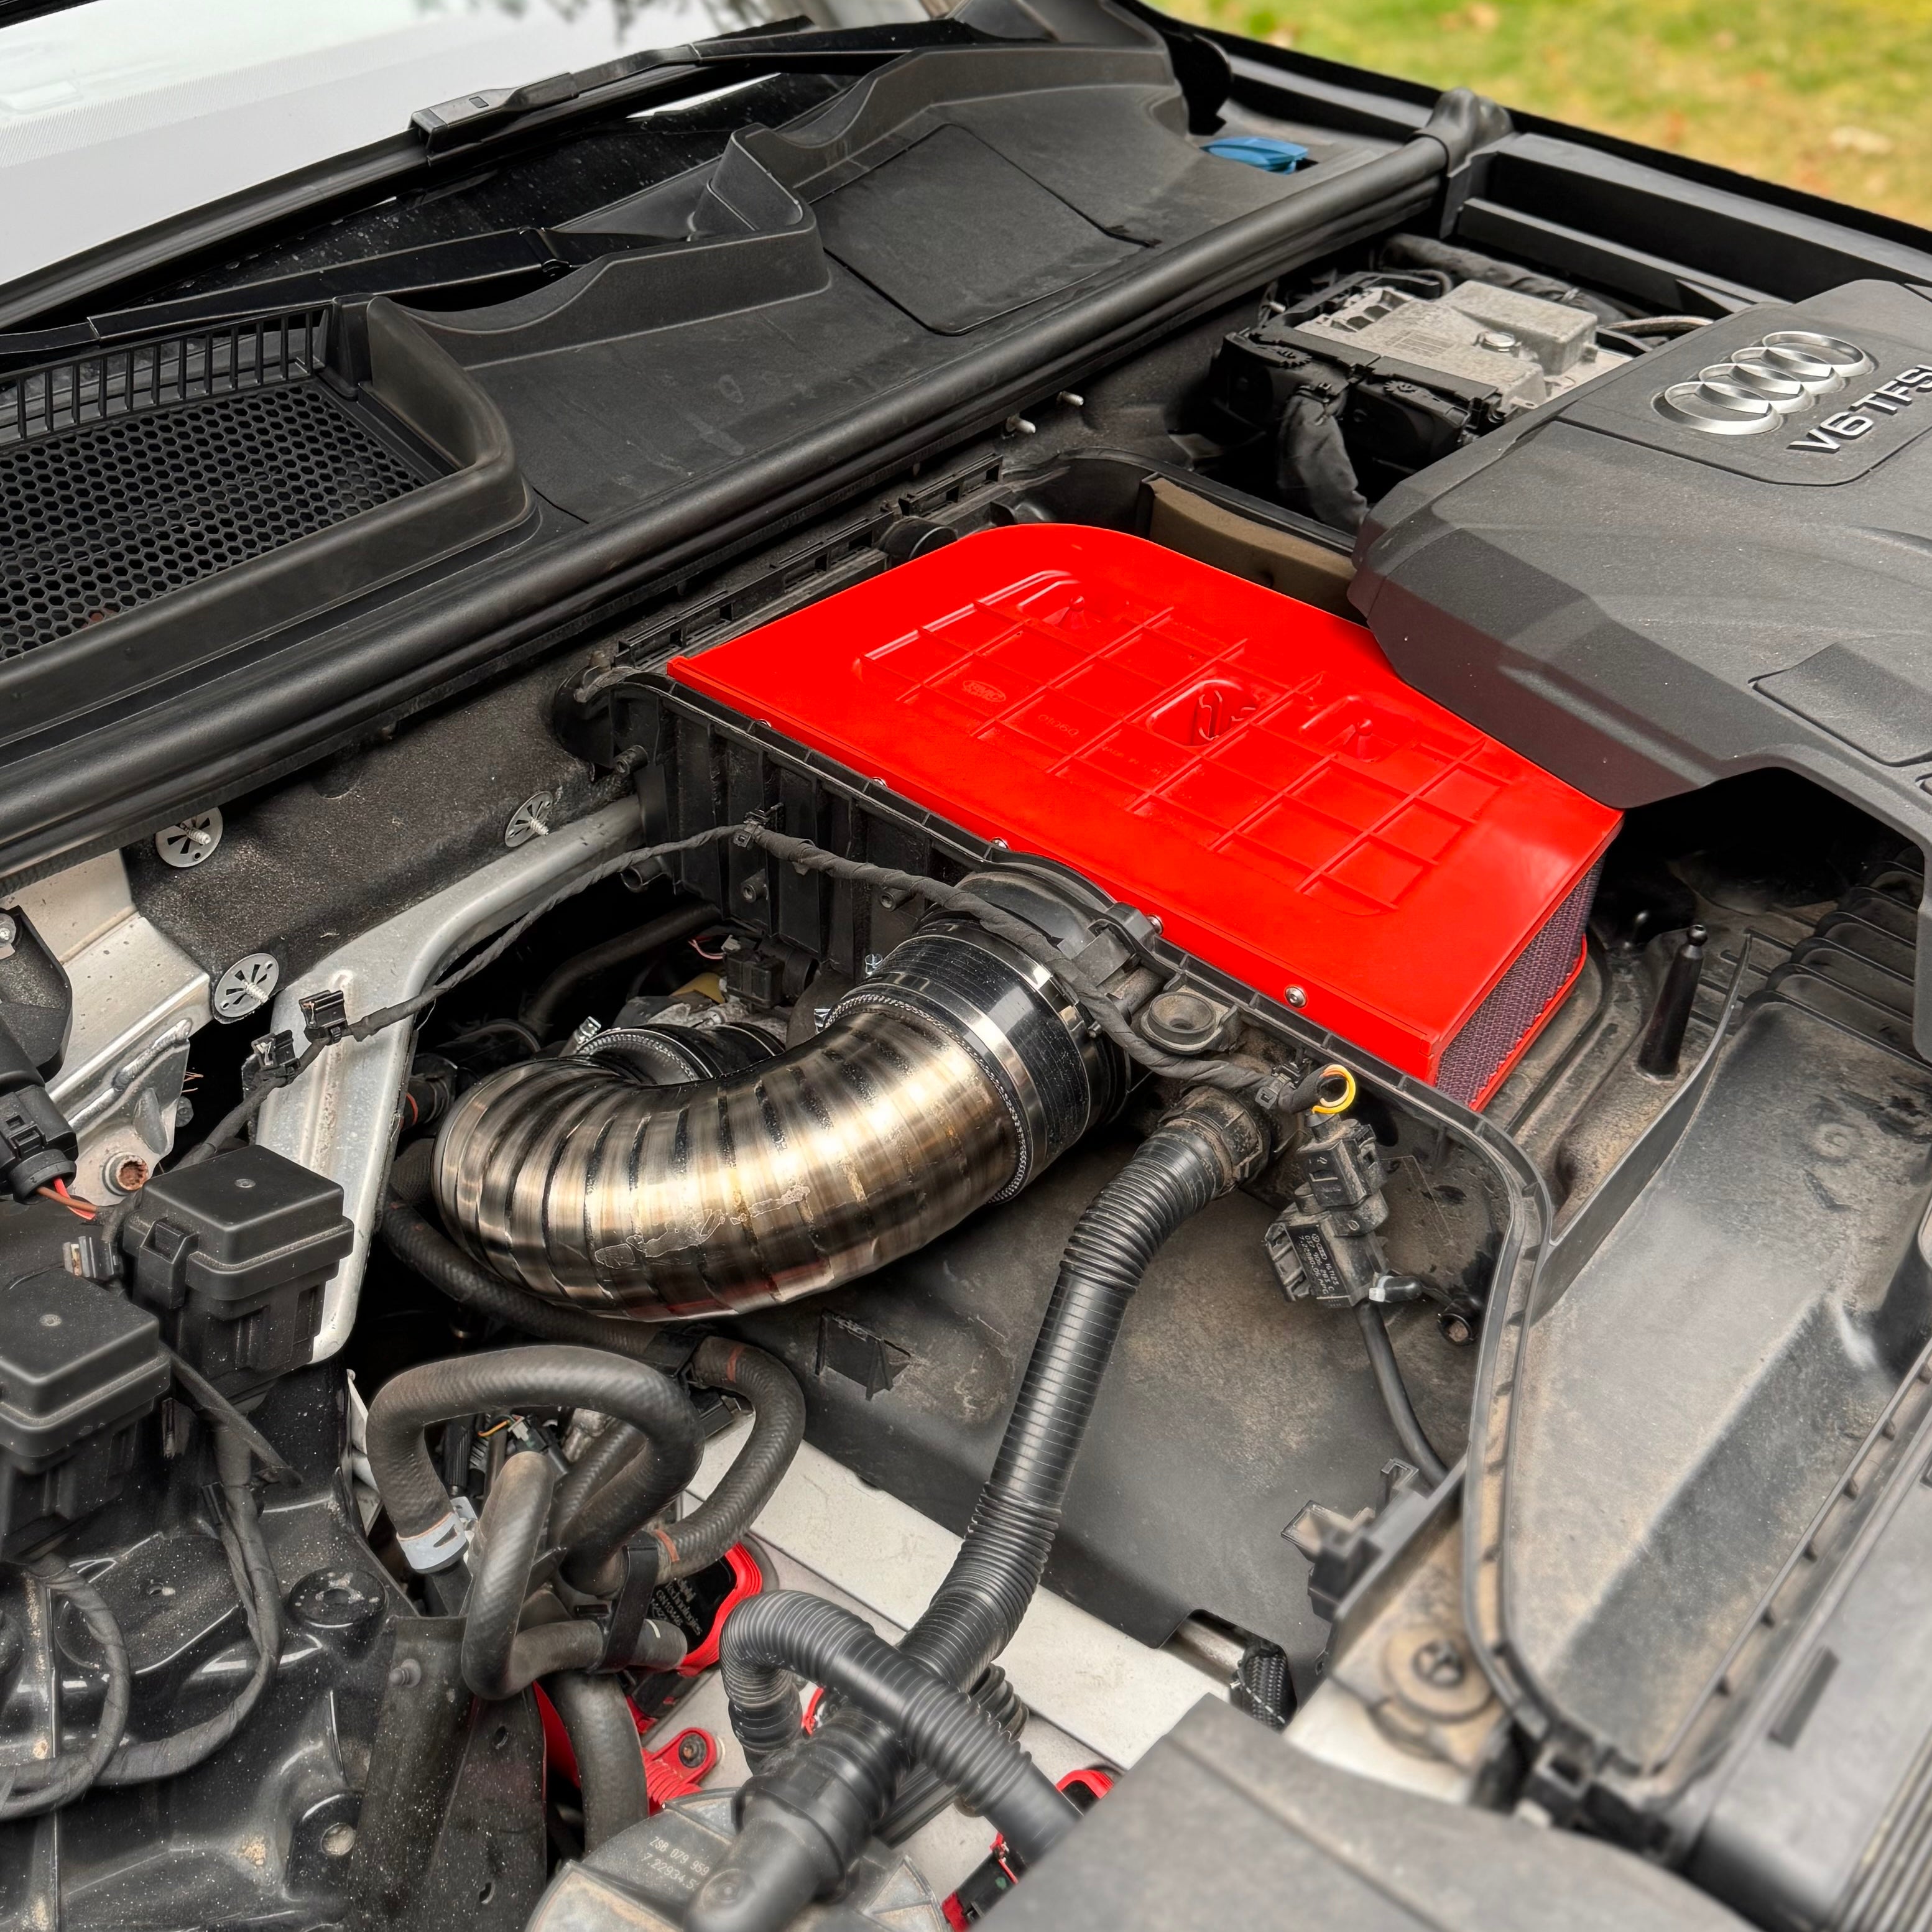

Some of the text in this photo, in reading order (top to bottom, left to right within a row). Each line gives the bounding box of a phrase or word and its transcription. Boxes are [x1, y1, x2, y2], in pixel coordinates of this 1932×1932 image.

[649, 1836, 710, 1876] ZSB 079 959
